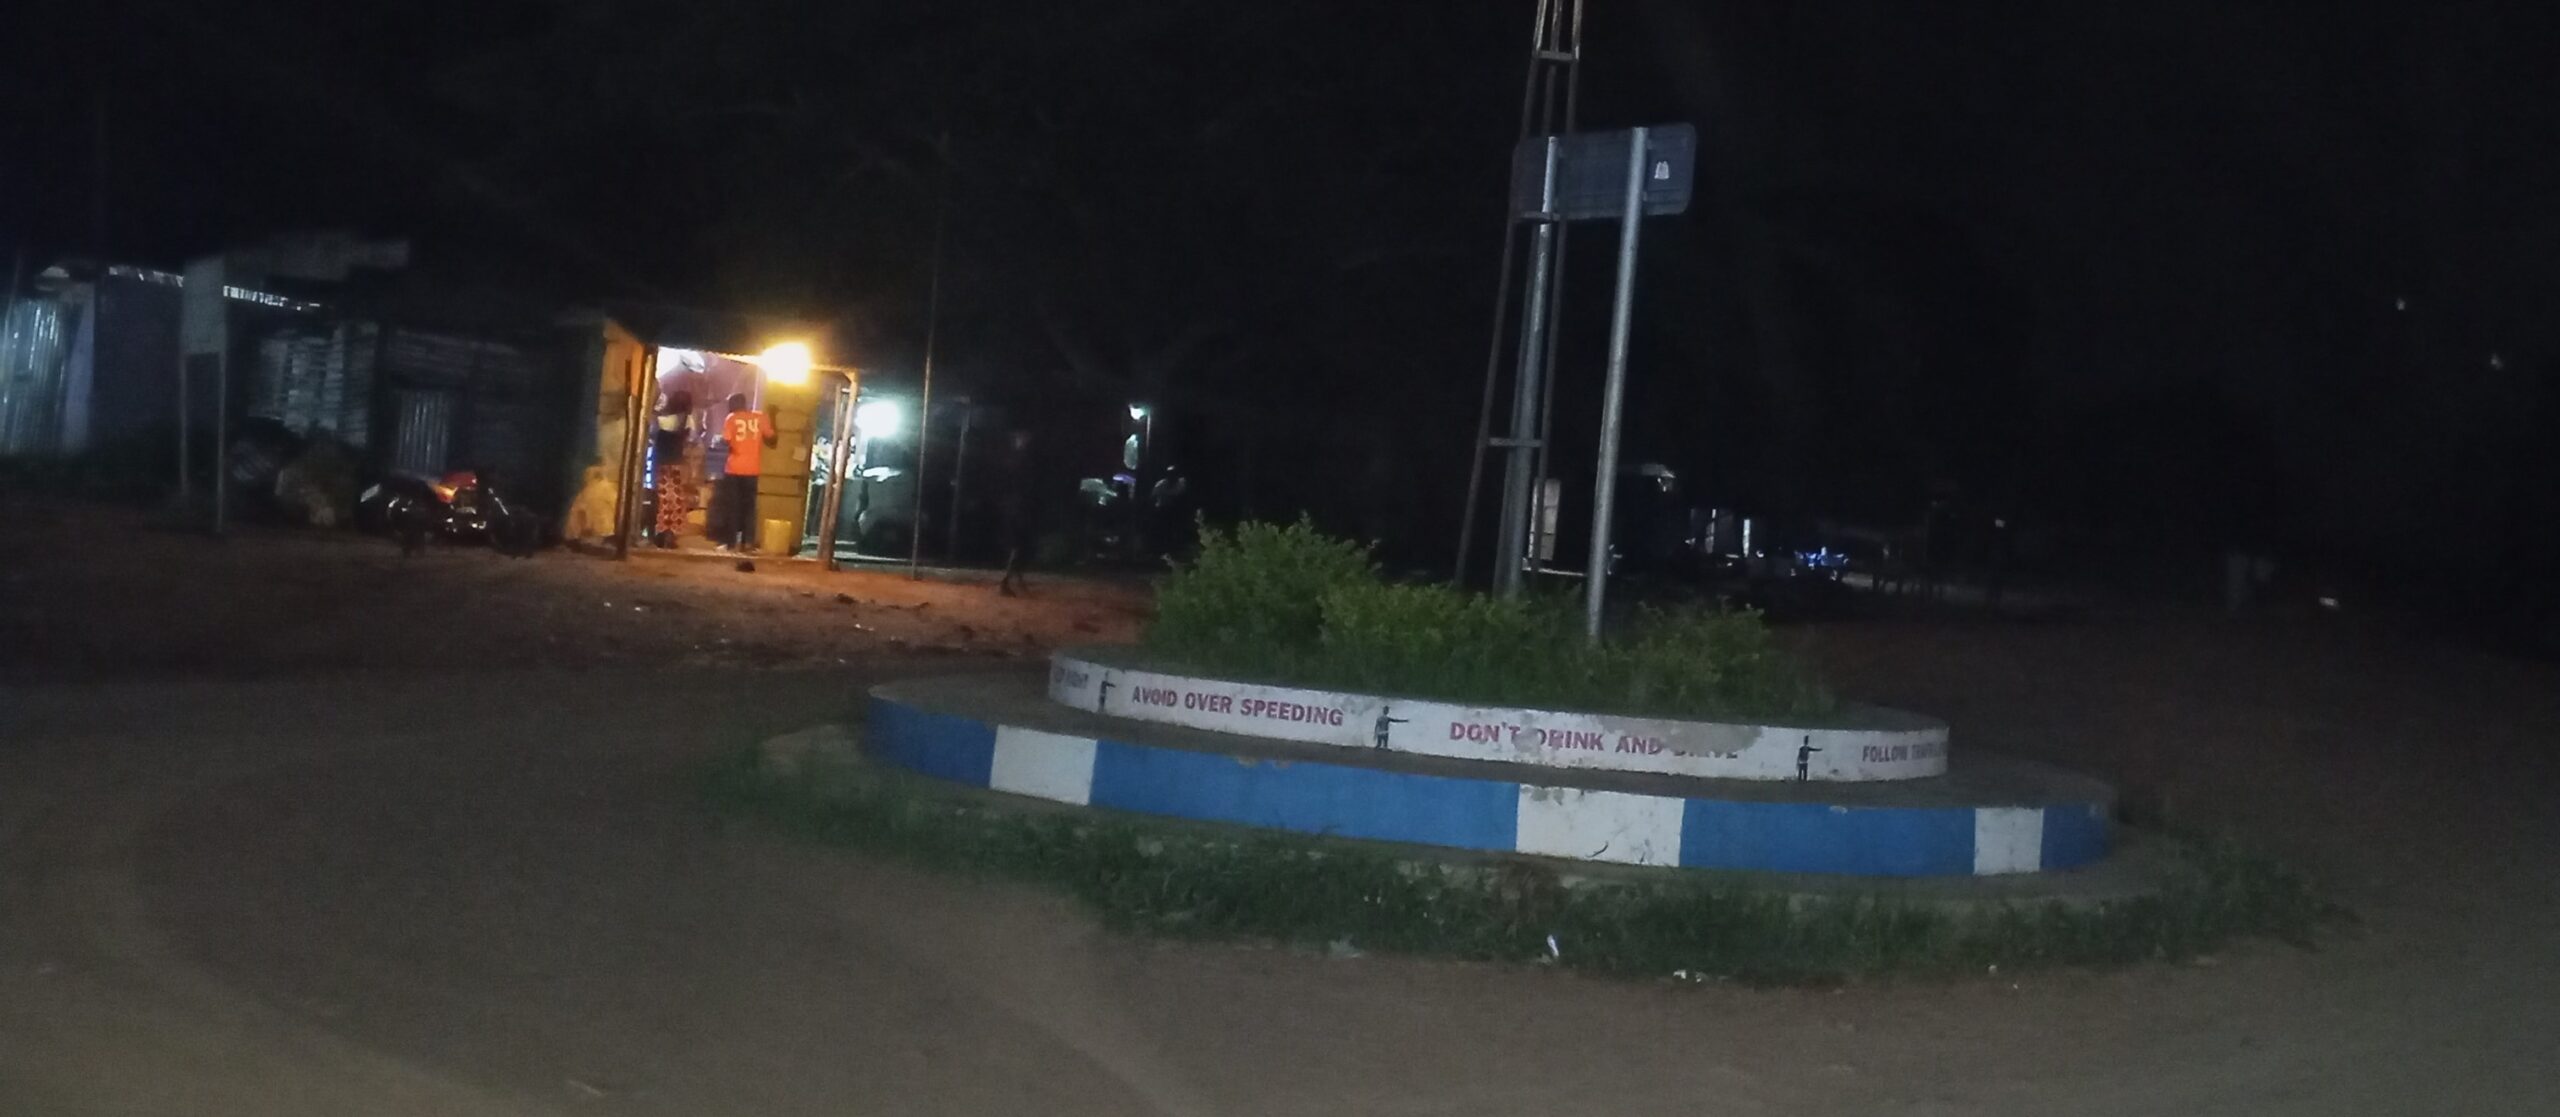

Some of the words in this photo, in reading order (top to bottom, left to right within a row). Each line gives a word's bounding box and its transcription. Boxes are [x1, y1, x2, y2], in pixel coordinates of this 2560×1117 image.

[735, 418, 759, 442] 34
[1133, 686, 1178, 707] AVOID
[1184, 692, 1232, 715] OVER
[1239, 700, 1344, 727] SPEEDING
[1615, 735, 1664, 755] AND
